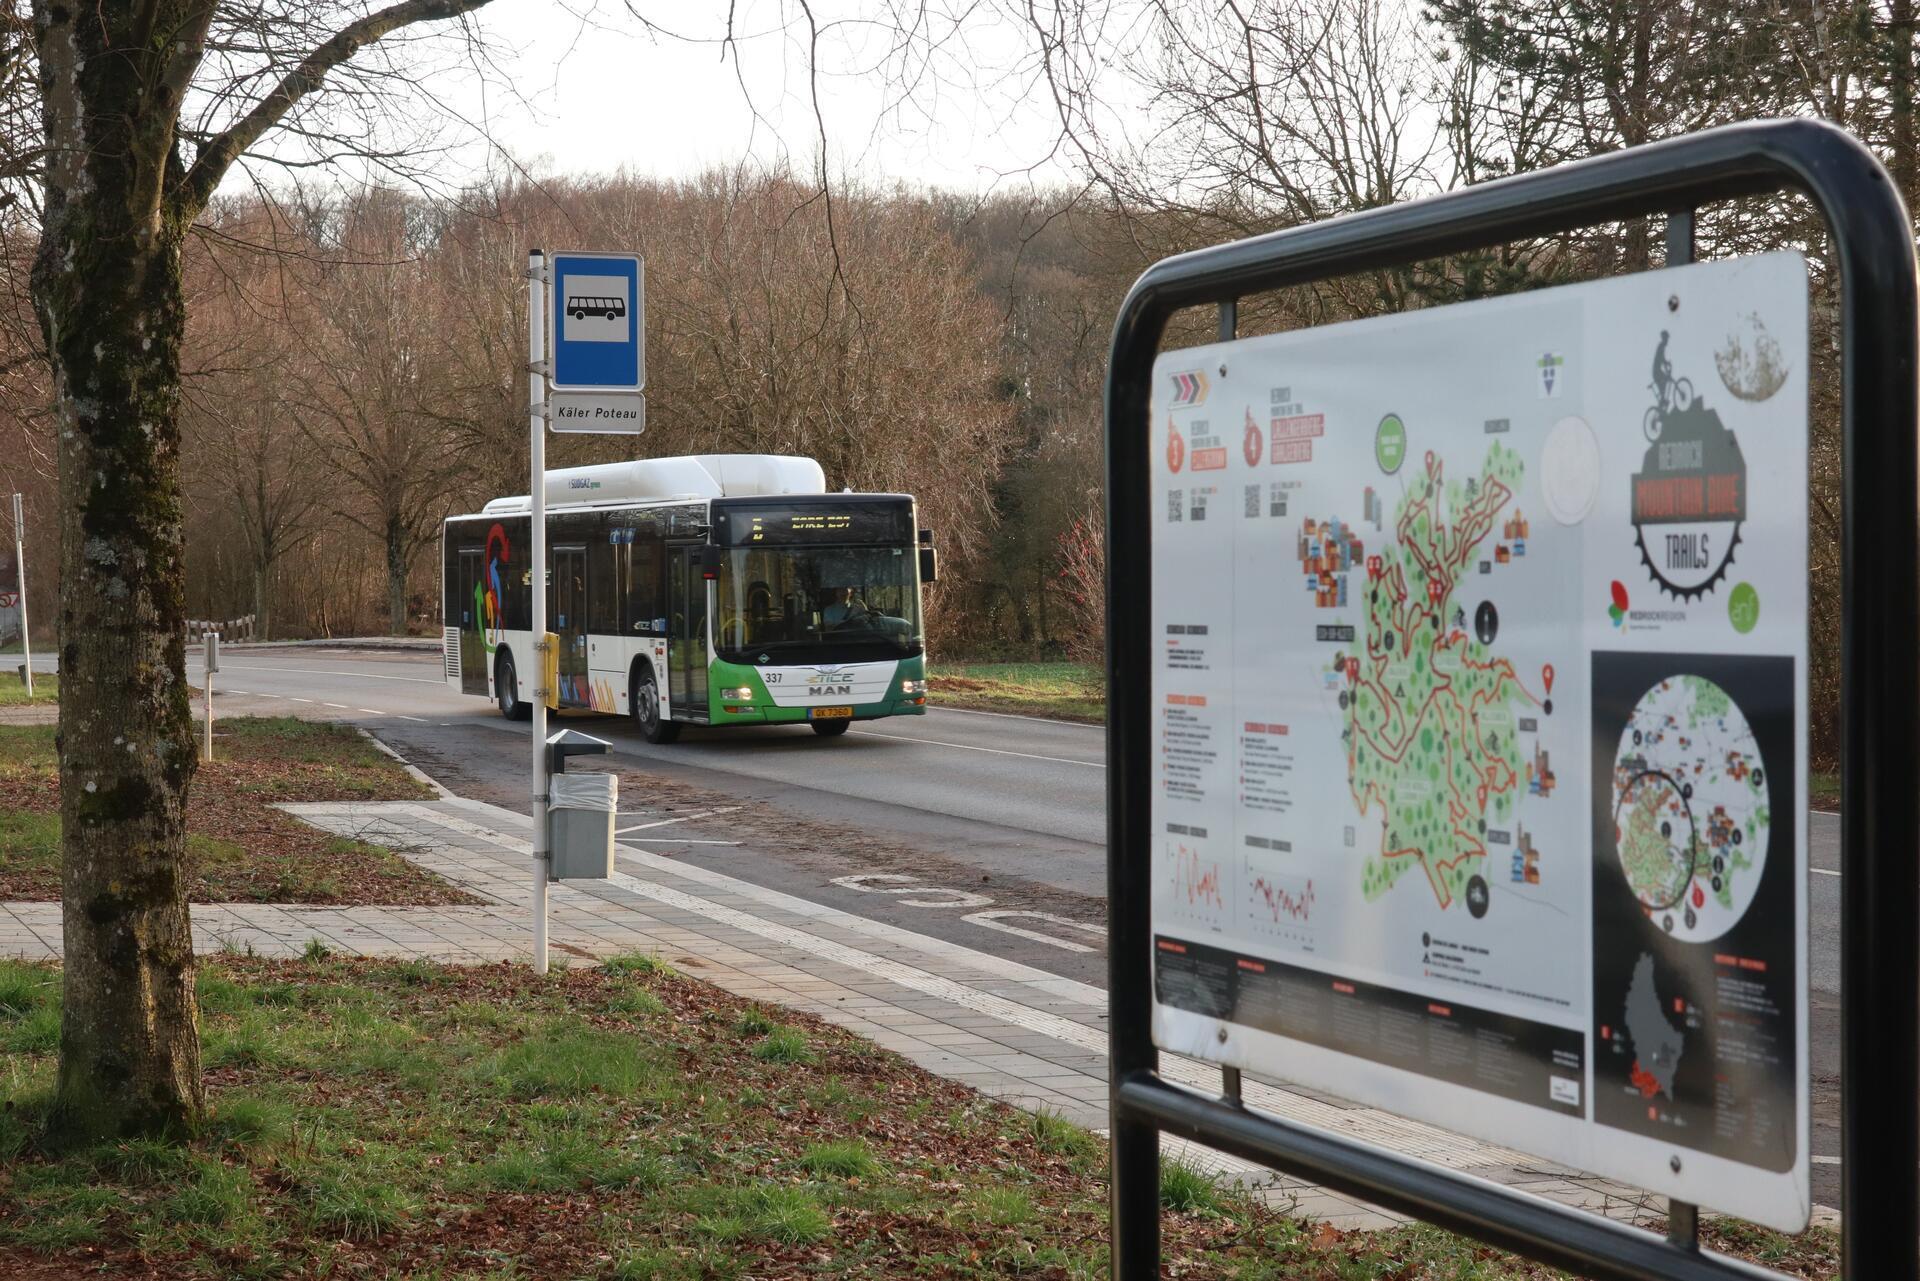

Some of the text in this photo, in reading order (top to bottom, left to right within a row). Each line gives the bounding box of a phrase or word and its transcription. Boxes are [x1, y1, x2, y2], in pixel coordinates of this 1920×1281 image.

[558, 407, 637, 419] Käler Poteau
[1665, 532, 1709, 570] TRAILS
[765, 673, 782, 683] 337
[809, 686, 850, 695] MAN
